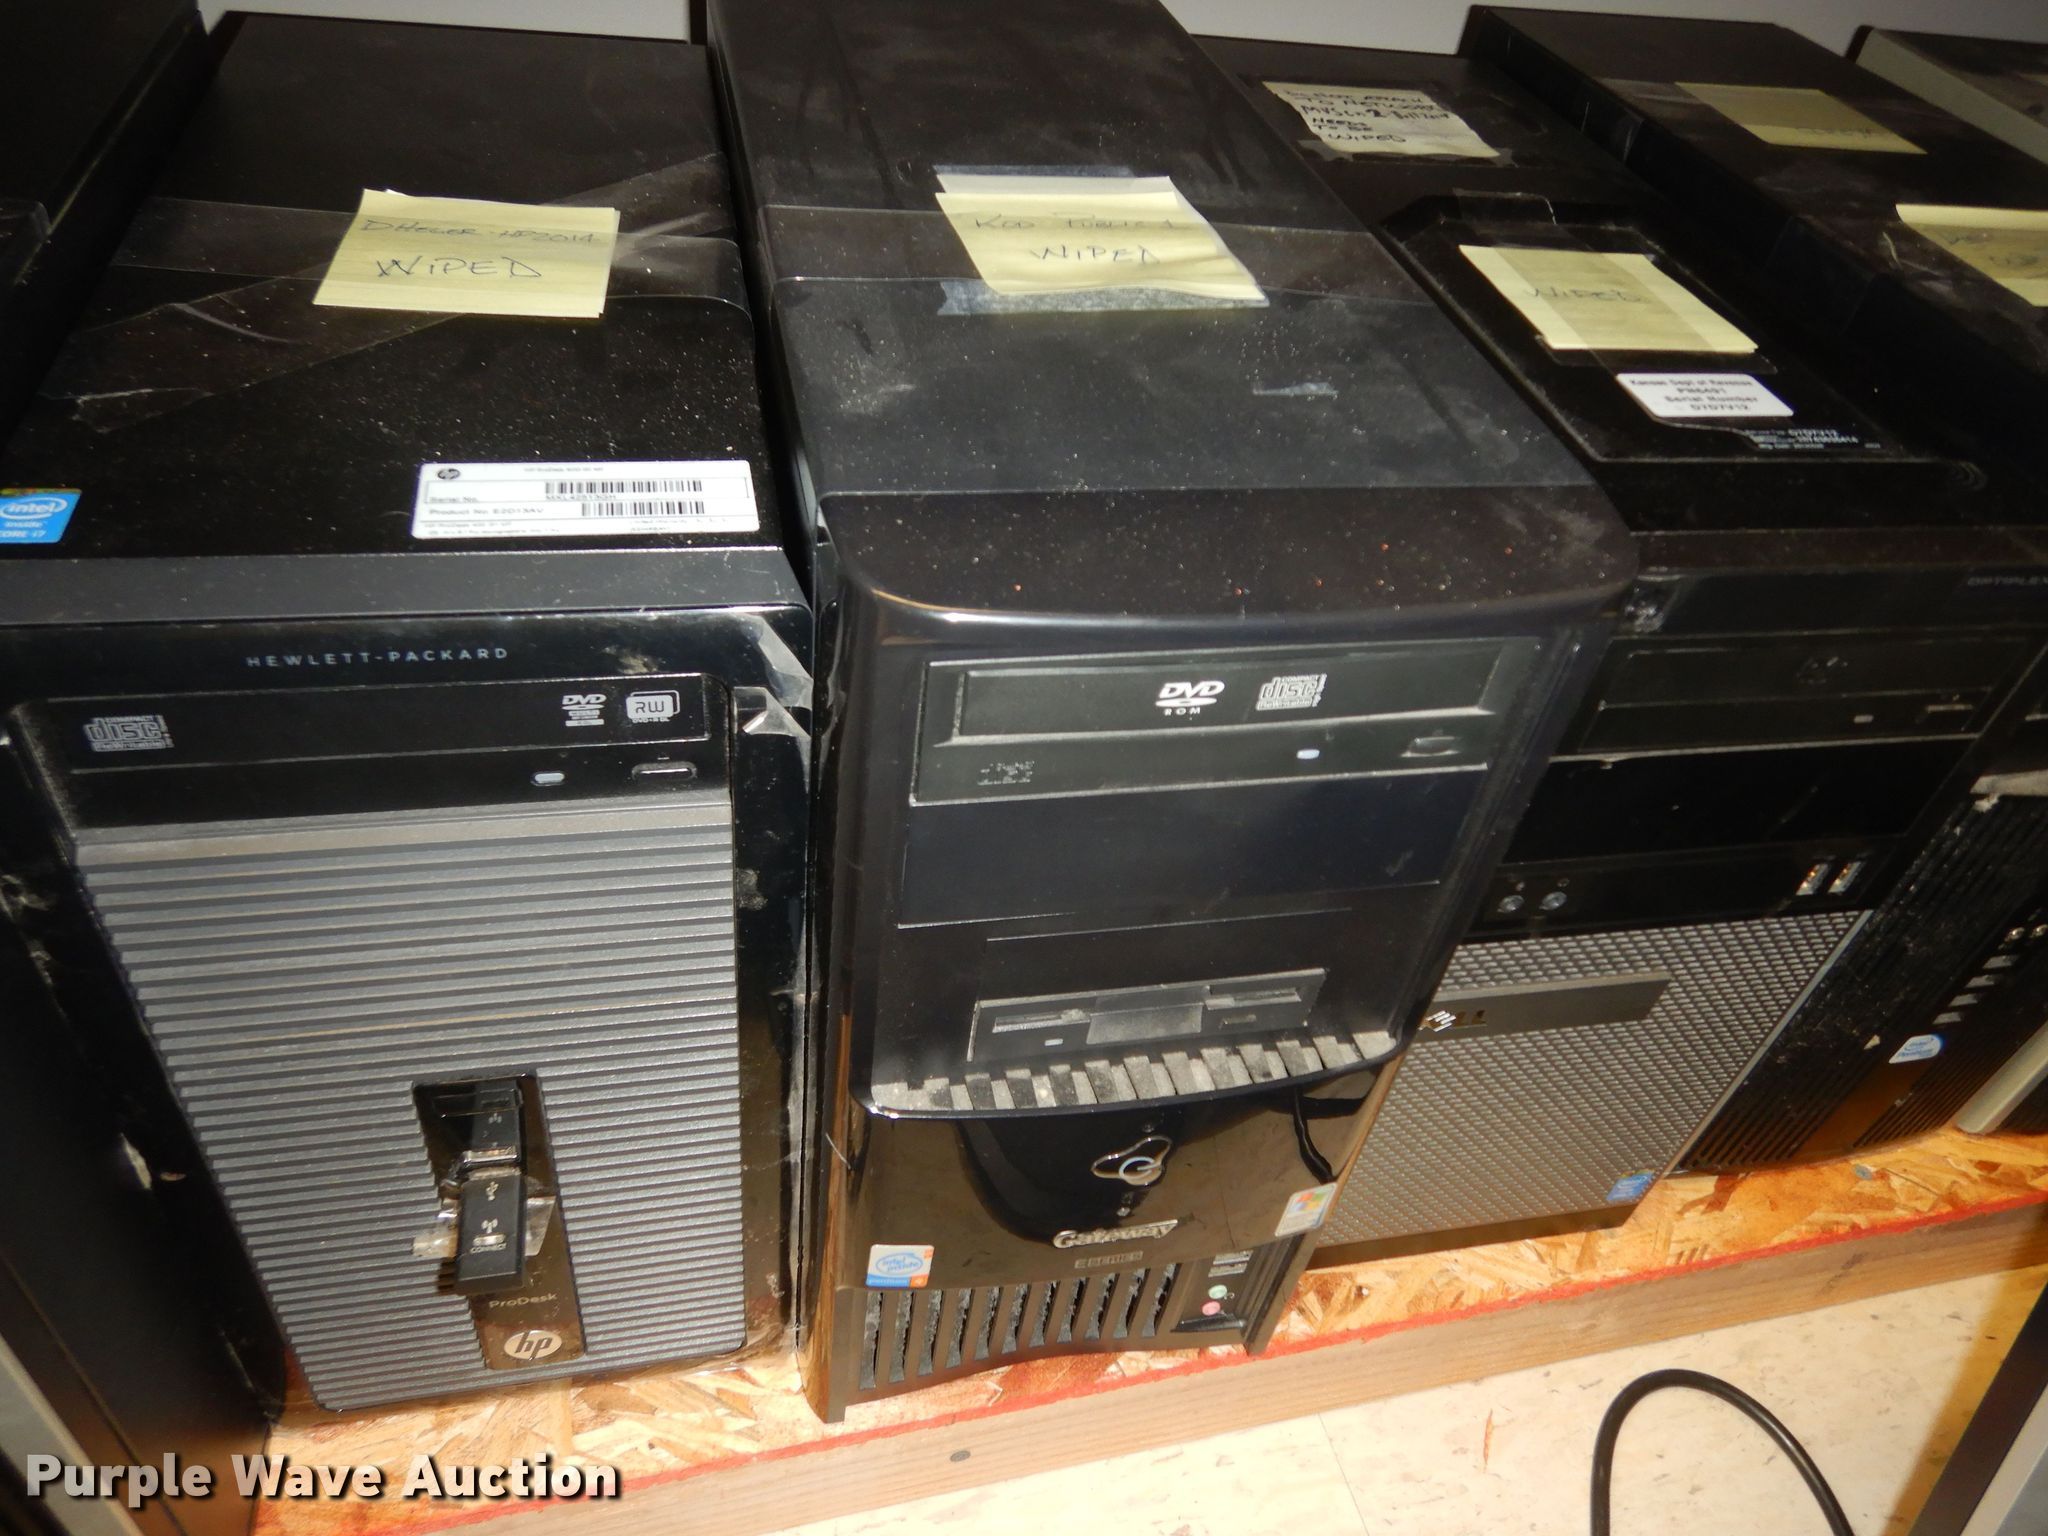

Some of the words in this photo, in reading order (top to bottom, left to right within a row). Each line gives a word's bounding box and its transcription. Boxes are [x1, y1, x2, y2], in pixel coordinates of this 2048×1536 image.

[1028, 244, 1161, 264] WIPED
[374, 254, 543, 281] WIPED
[246, 648, 508, 667] HEWLETT-PACKARD
[1158, 681, 1225, 699] DVD
[562, 694, 607, 705] DVD
[635, 701, 665, 713] RW
[1164, 707, 1200, 716] ROM
[488, 1292, 558, 1310] ProDesk
[513, 1331, 556, 1361] hp
